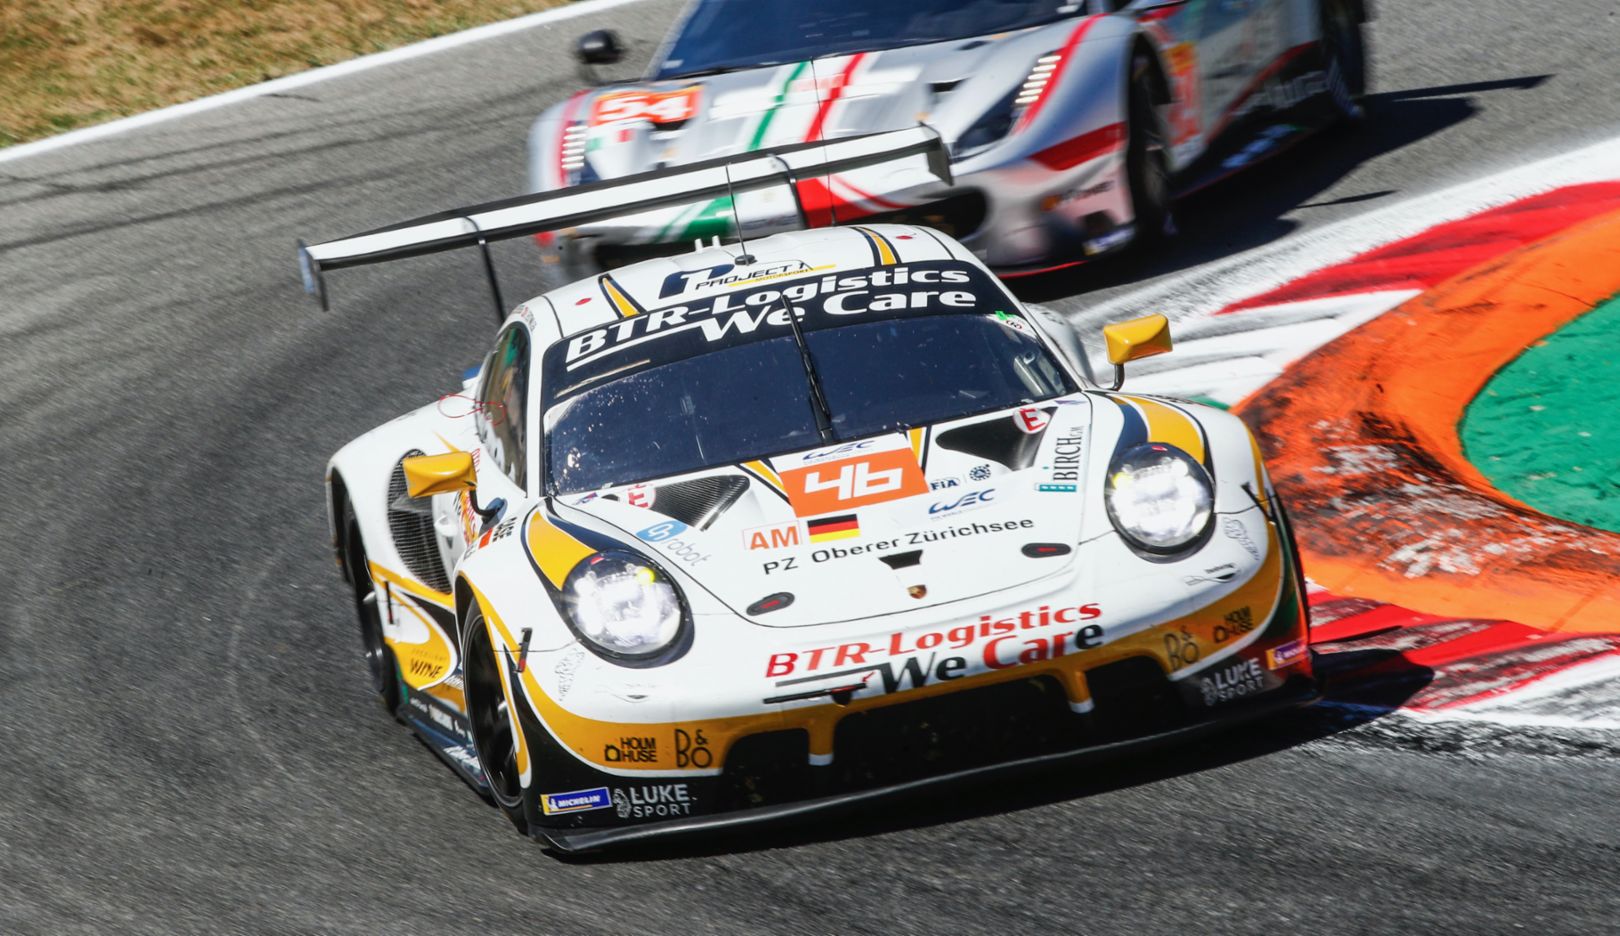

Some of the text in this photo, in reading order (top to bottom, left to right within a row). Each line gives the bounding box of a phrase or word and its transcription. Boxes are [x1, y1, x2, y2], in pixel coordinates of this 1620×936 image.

[599, 95, 694, 122] 54
[695, 263, 793, 290] PROJECT
[565, 267, 970, 363] BTR-Logistics
[700, 290, 977, 342] We Care
[1053, 437, 1082, 481] BIRCH
[804, 461, 903, 500] 46
[928, 488, 996, 514] WEC
[750, 526, 799, 550] AM
[763, 519, 1034, 575] PZ Oberer Zürichsee
[766, 603, 1102, 677] BTR-Logistics
[410, 660, 442, 678] WINE
[879, 625, 1104, 694] We Care
[1215, 658, 1263, 689] LUKE
[1219, 677, 1263, 701] SPORT
[620, 737, 656, 749] HOLM
[621, 751, 657, 762] HUSE
[630, 784, 688, 804] LUKE
[633, 803, 691, 817] SPORT
